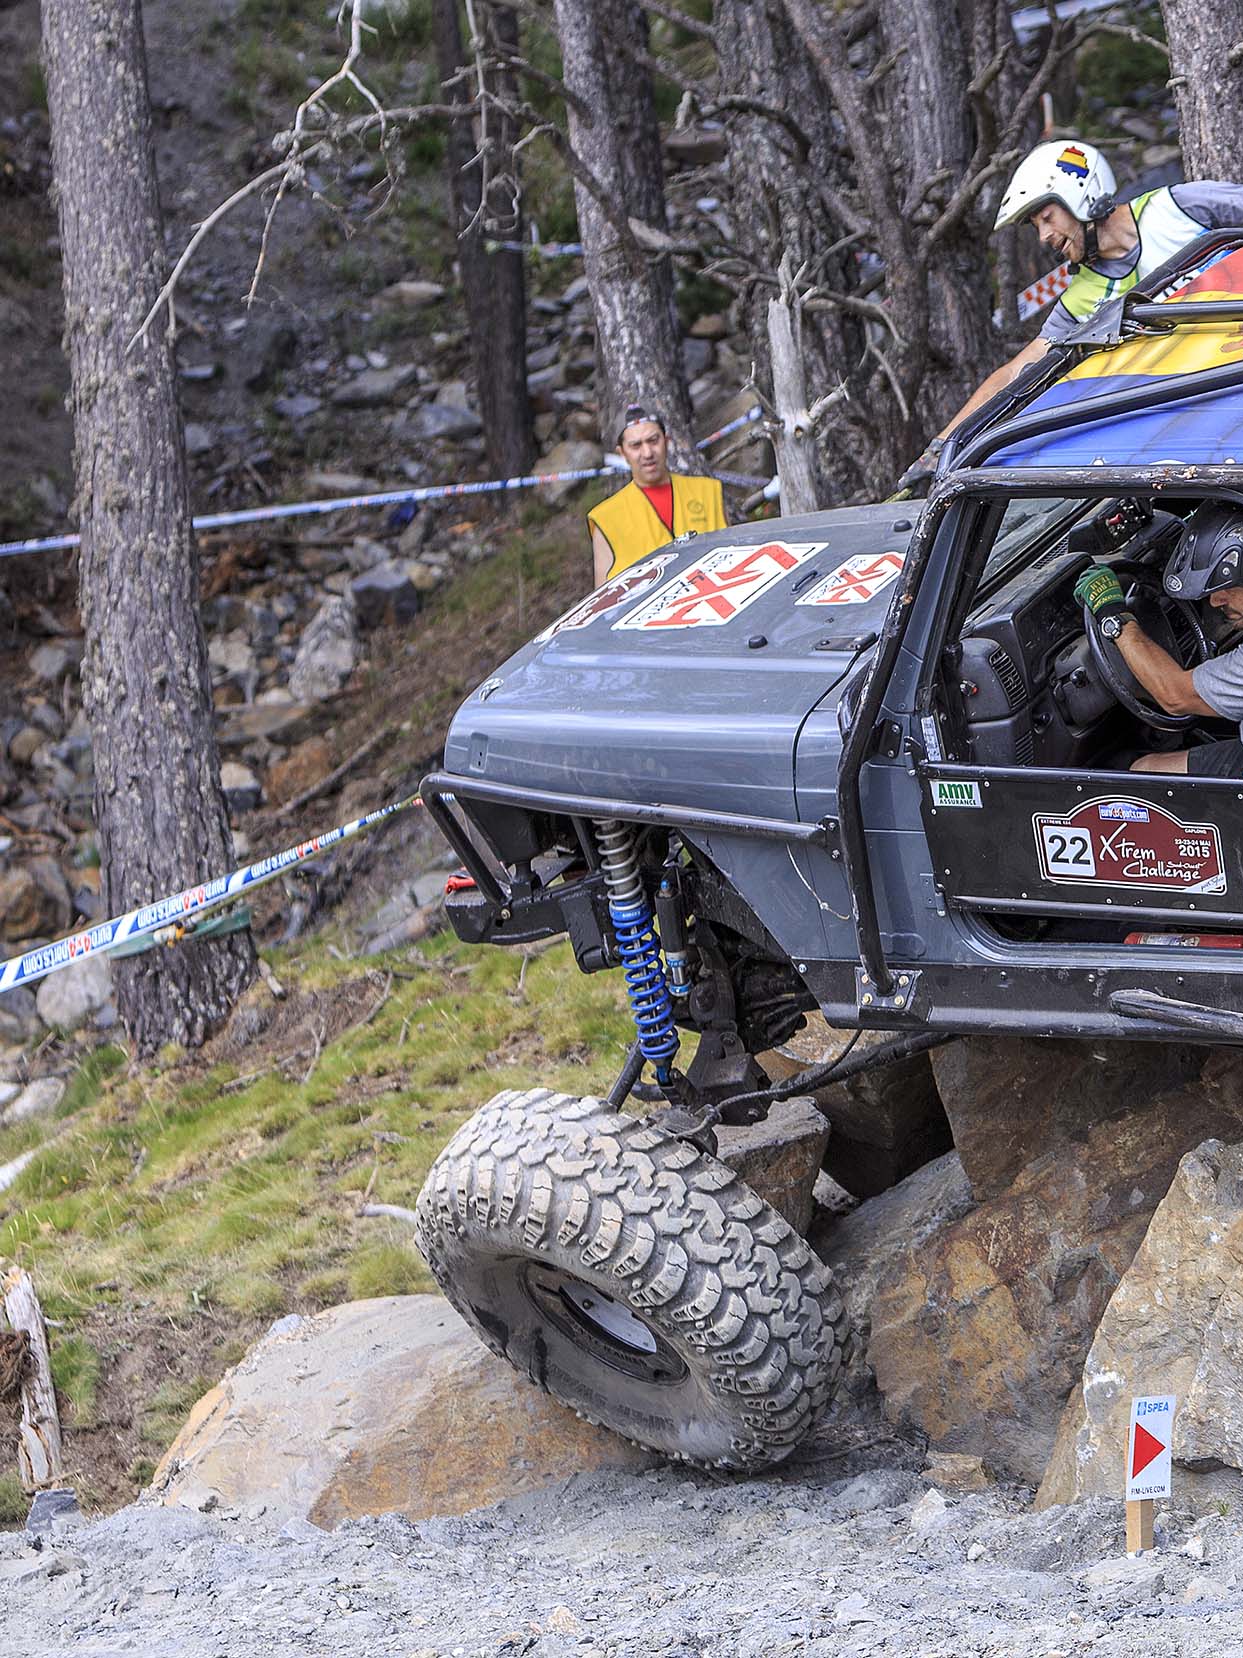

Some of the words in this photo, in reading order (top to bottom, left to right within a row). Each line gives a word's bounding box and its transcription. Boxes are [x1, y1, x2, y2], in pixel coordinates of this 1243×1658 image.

[1048, 834, 1091, 866] 22
[1099, 822, 1156, 862] Xtrem
[1178, 845, 1210, 858] 2015
[1122, 859, 1202, 882] Challenge
[1147, 1401, 1169, 1413] SPEA
